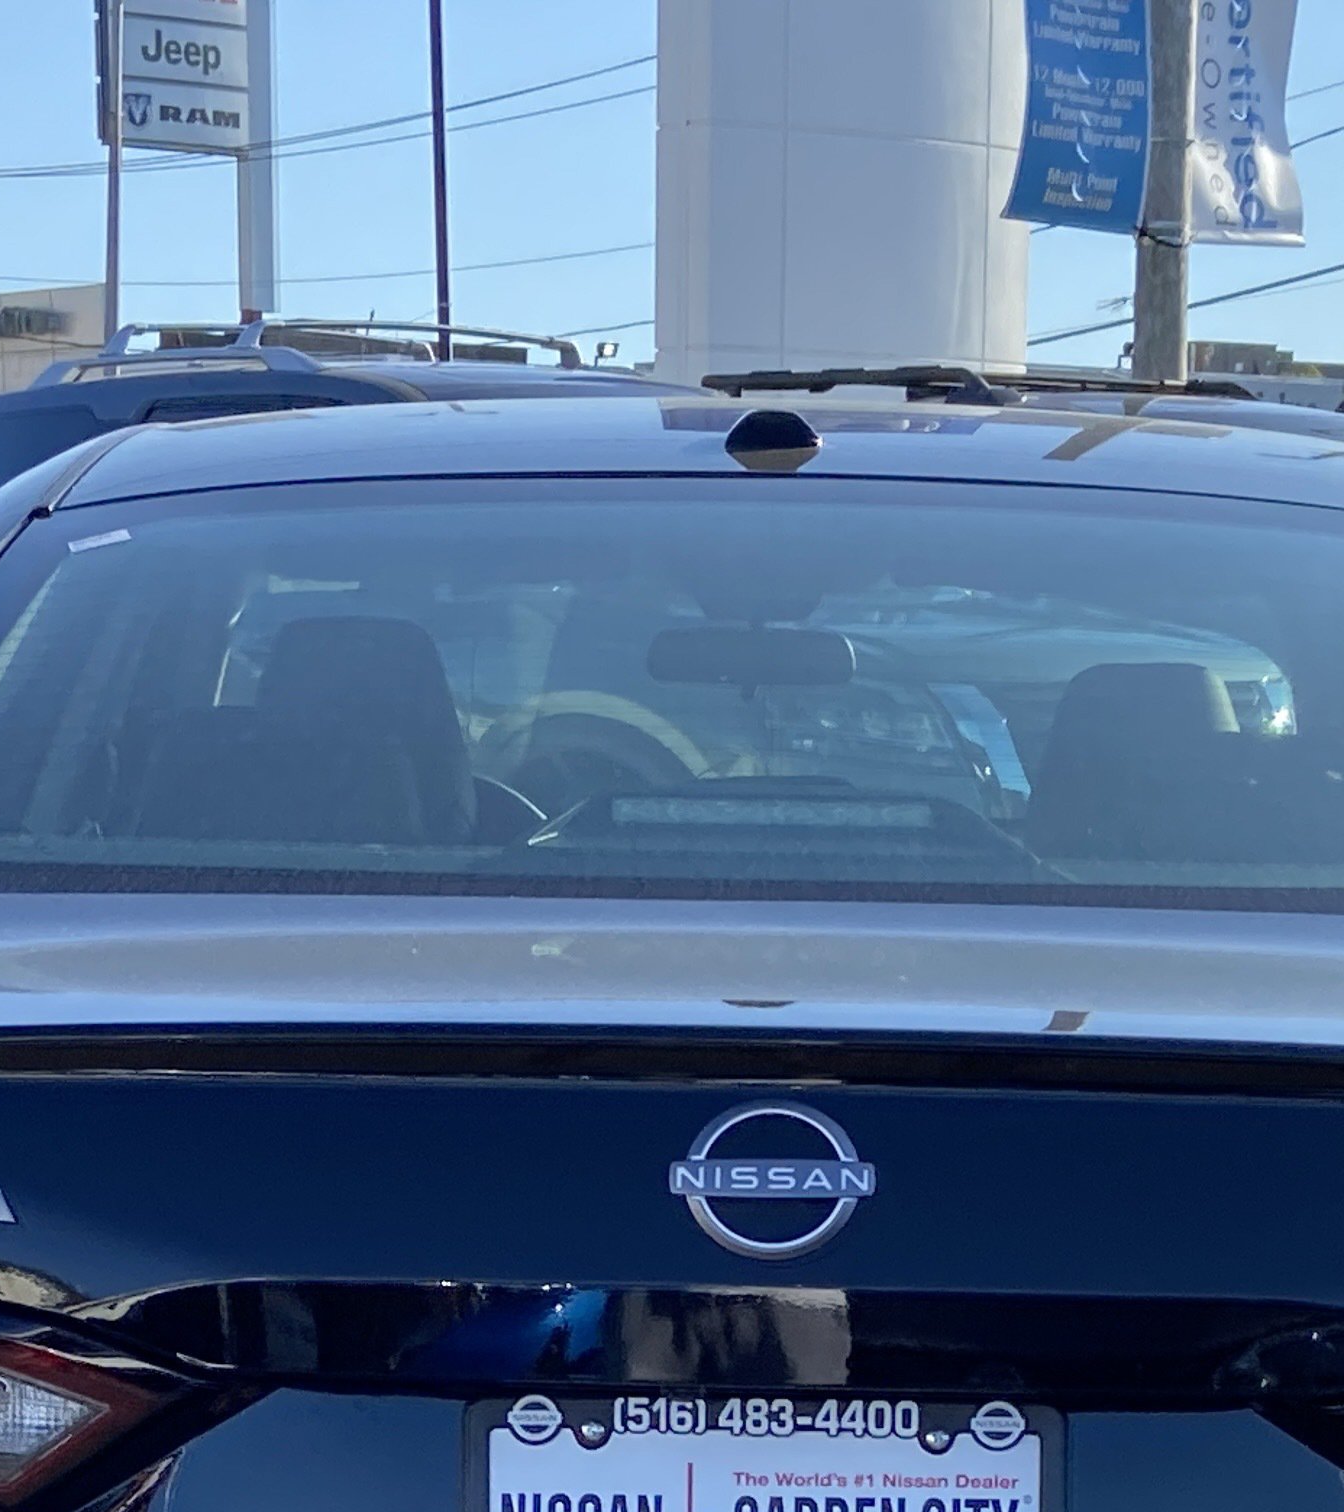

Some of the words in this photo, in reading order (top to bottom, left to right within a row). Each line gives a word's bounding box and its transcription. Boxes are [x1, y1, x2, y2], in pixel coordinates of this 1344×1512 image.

[141, 28, 221, 76] Jeep
[159, 104, 240, 129] RAM
[676, 1166, 869, 1191] NISSAN
[613, 1397, 707, 1434] (516)
[718, 1398, 920, 1438] 483-4400
[733, 1472, 769, 1487] The
[774, 1472, 847, 1488] World's
[854, 1473, 875, 1488] #1
[883, 1473, 949, 1489] Nissan
[956, 1474, 1020, 1490] Dealer
